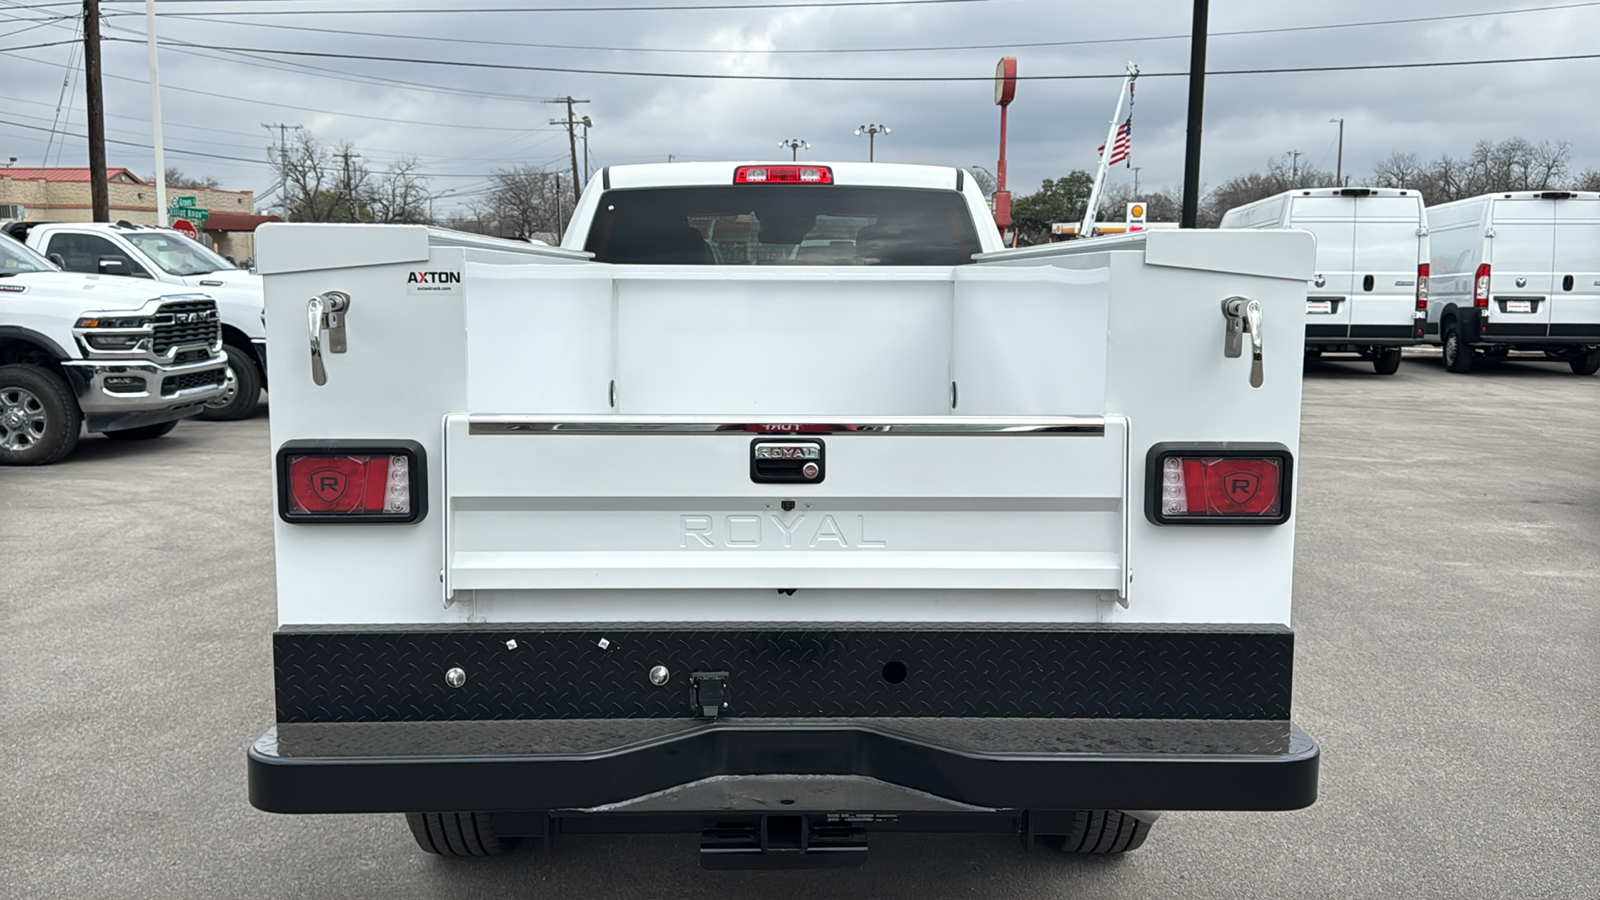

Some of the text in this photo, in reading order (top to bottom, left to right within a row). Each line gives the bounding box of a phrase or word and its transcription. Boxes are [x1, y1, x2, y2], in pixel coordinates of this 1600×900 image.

[188, 210, 202, 219] Knox
[408, 271, 461, 284] AXTON
[176, 311, 209, 324] RAM
[759, 447, 819, 458] ROYAL
[320, 477, 339, 493] R
[1232, 479, 1250, 494] R
[680, 514, 887, 548] ROYAL
